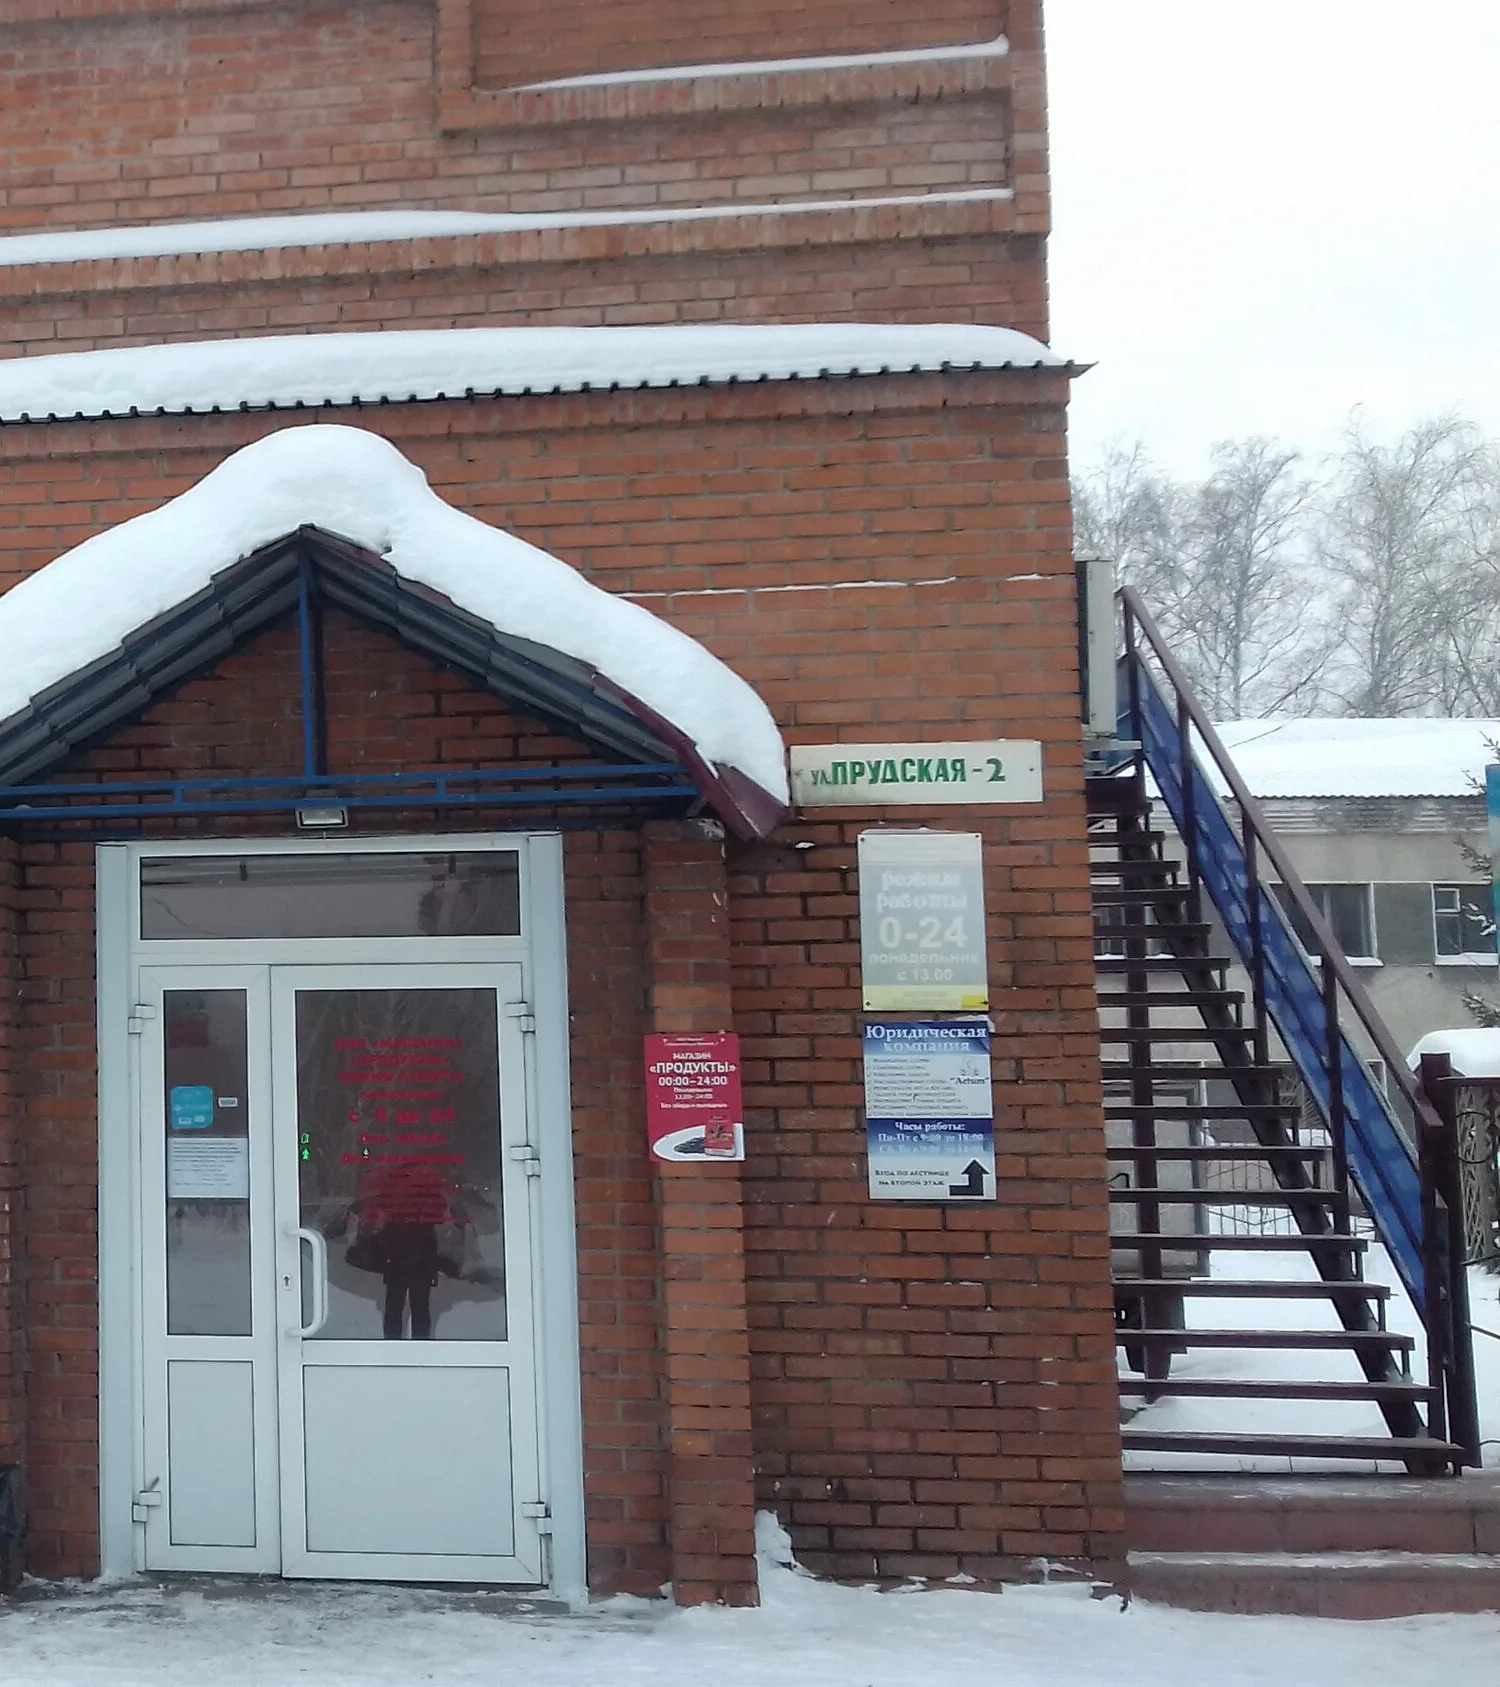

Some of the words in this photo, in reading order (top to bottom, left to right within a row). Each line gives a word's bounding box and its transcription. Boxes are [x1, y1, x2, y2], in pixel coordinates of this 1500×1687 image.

[866, 1025, 987, 1041] Юридическая
[883, 1042, 970, 1052] компания
[649, 1062, 737, 1074] «ПРОДУКТЫ»
[895, 1121, 922, 1131] Часы
[925, 1121, 966, 1132] работы:
